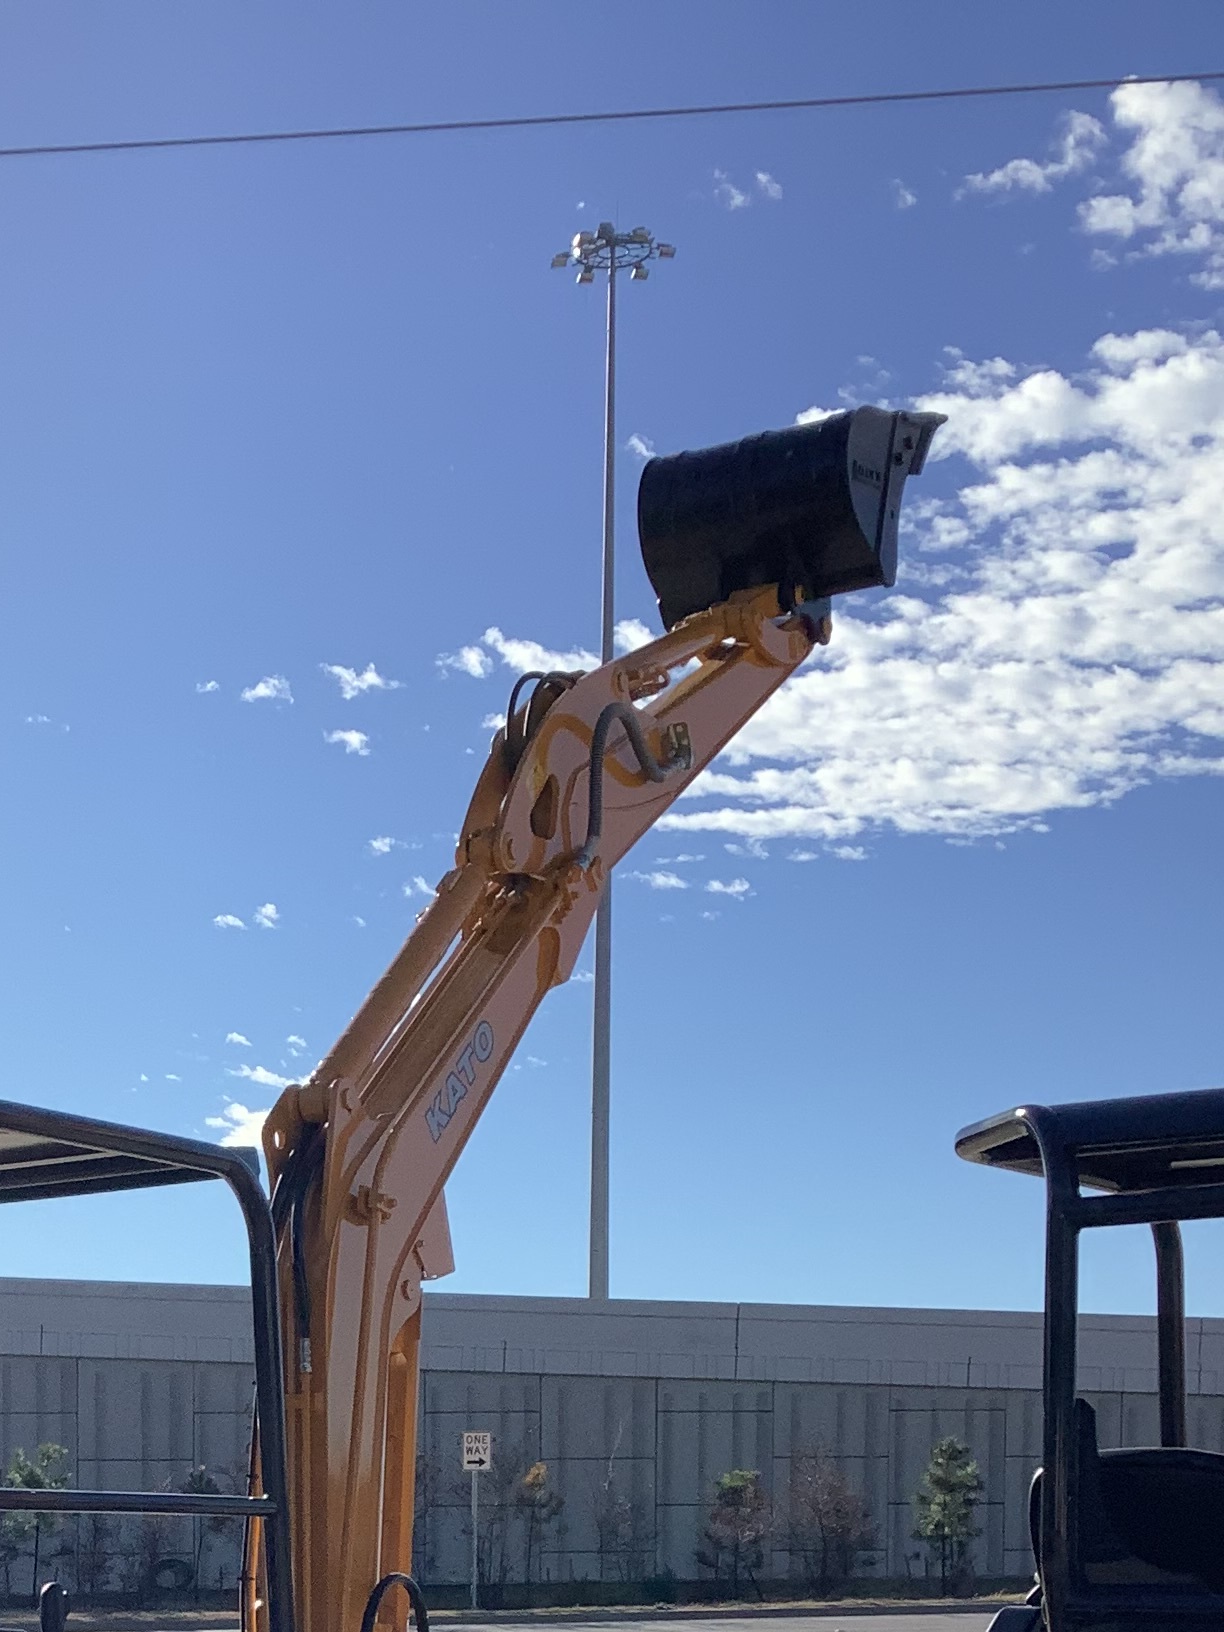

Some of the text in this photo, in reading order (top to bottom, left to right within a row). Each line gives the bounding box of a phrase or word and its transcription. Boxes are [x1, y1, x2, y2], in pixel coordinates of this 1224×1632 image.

[425, 1020, 494, 1144] KATO
[465, 1434, 489, 1445] ONE
[465, 1445, 489, 1455] WAY
